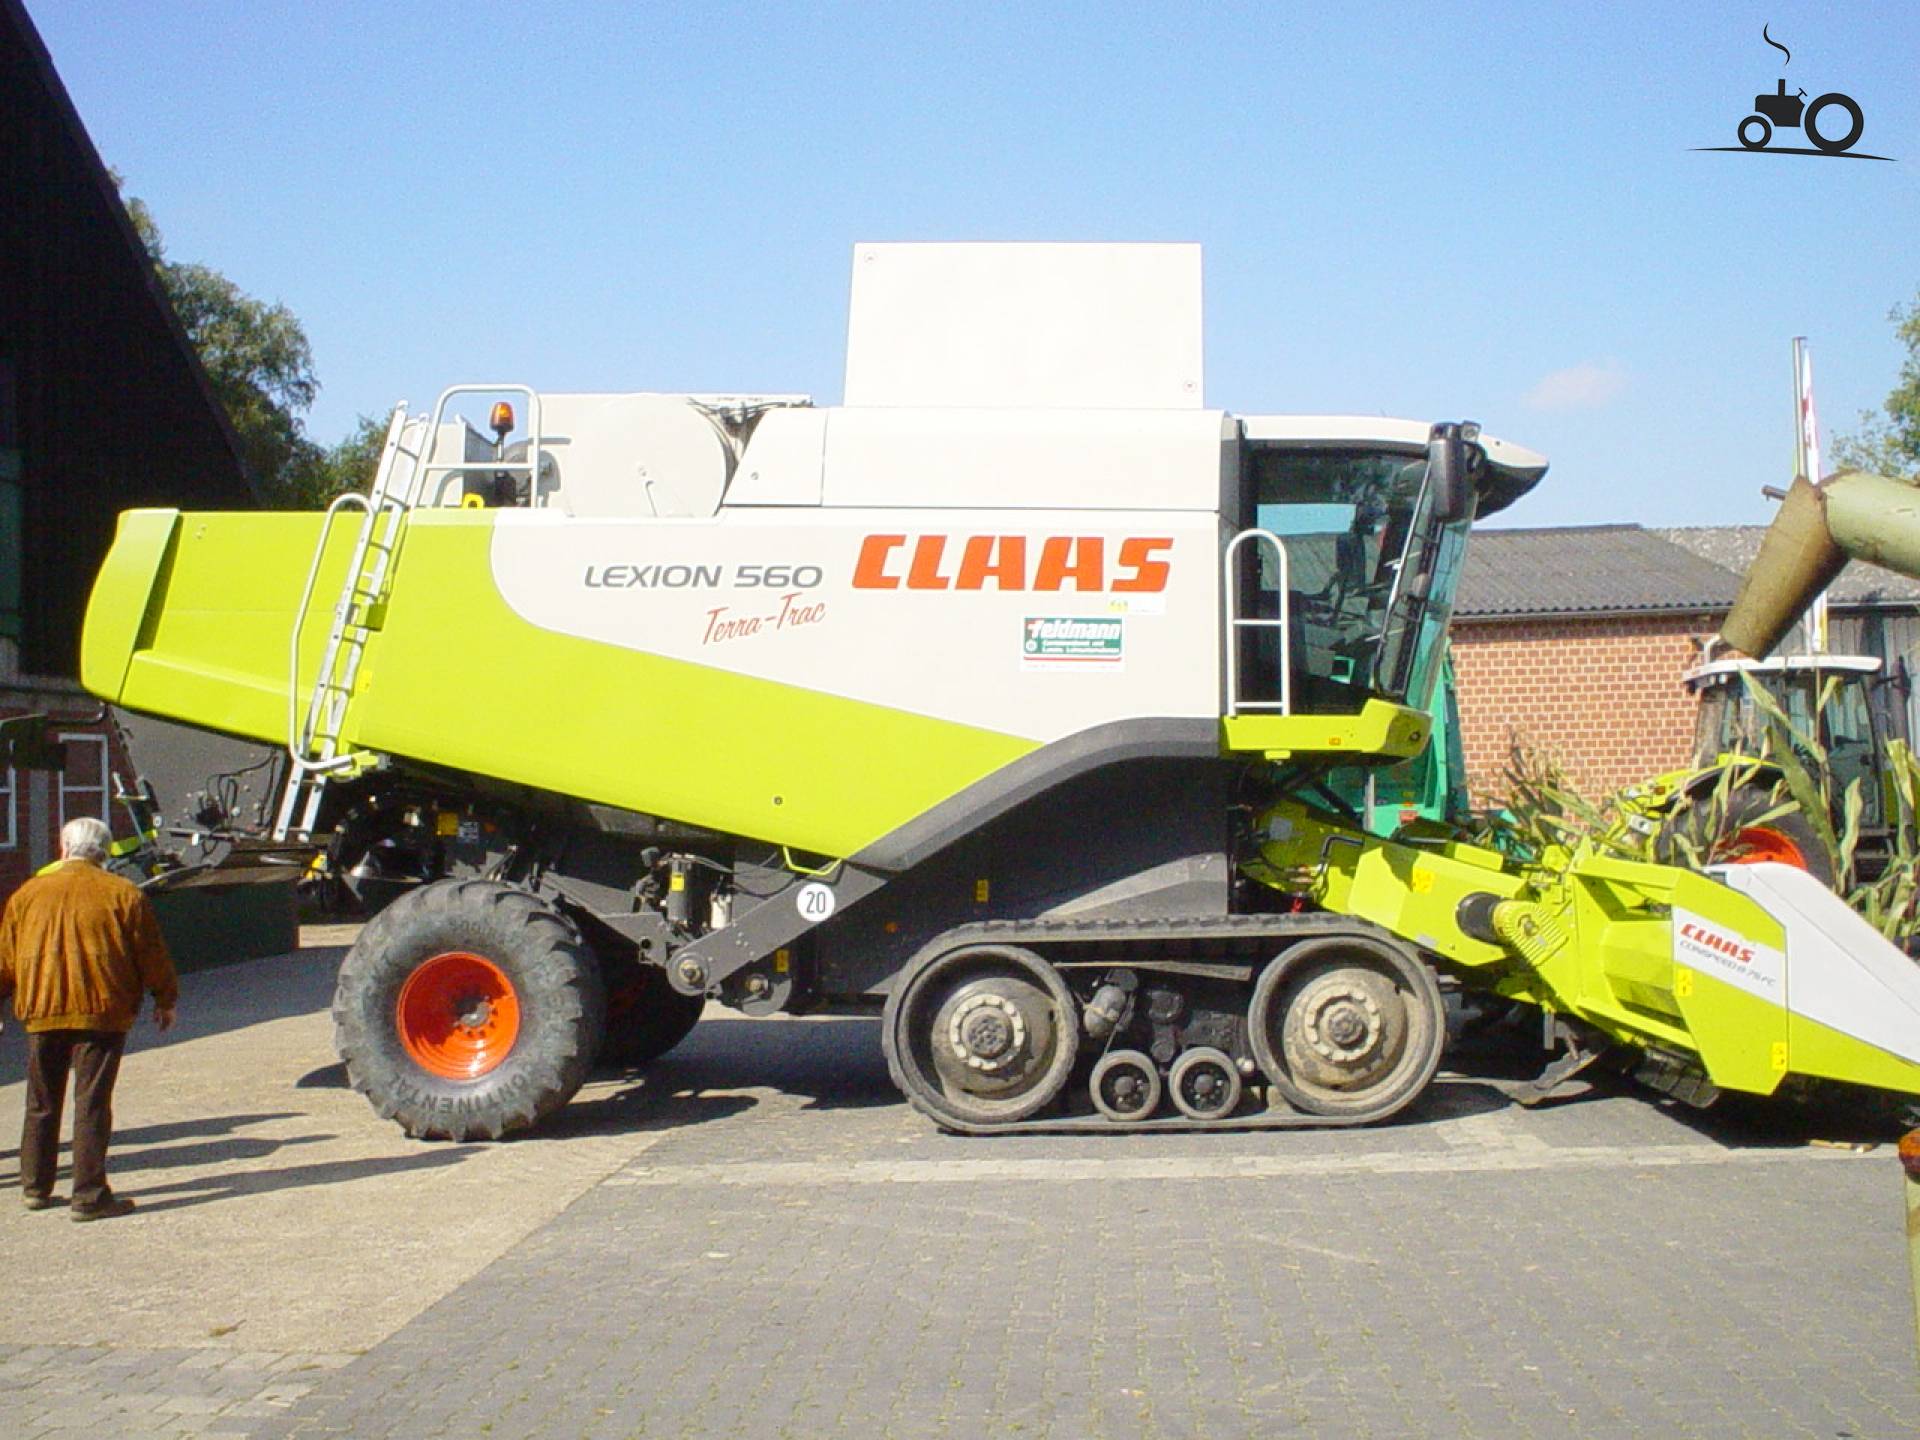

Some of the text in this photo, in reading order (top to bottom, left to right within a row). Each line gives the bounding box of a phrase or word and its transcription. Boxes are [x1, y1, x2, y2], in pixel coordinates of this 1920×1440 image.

[584, 566, 823, 588] LEXION 560
[851, 534, 1173, 593] CLAAS
[703, 592, 826, 645] Terra-Trac
[806, 891, 826, 913] 20
[1680, 923, 1755, 963] CLAAS
